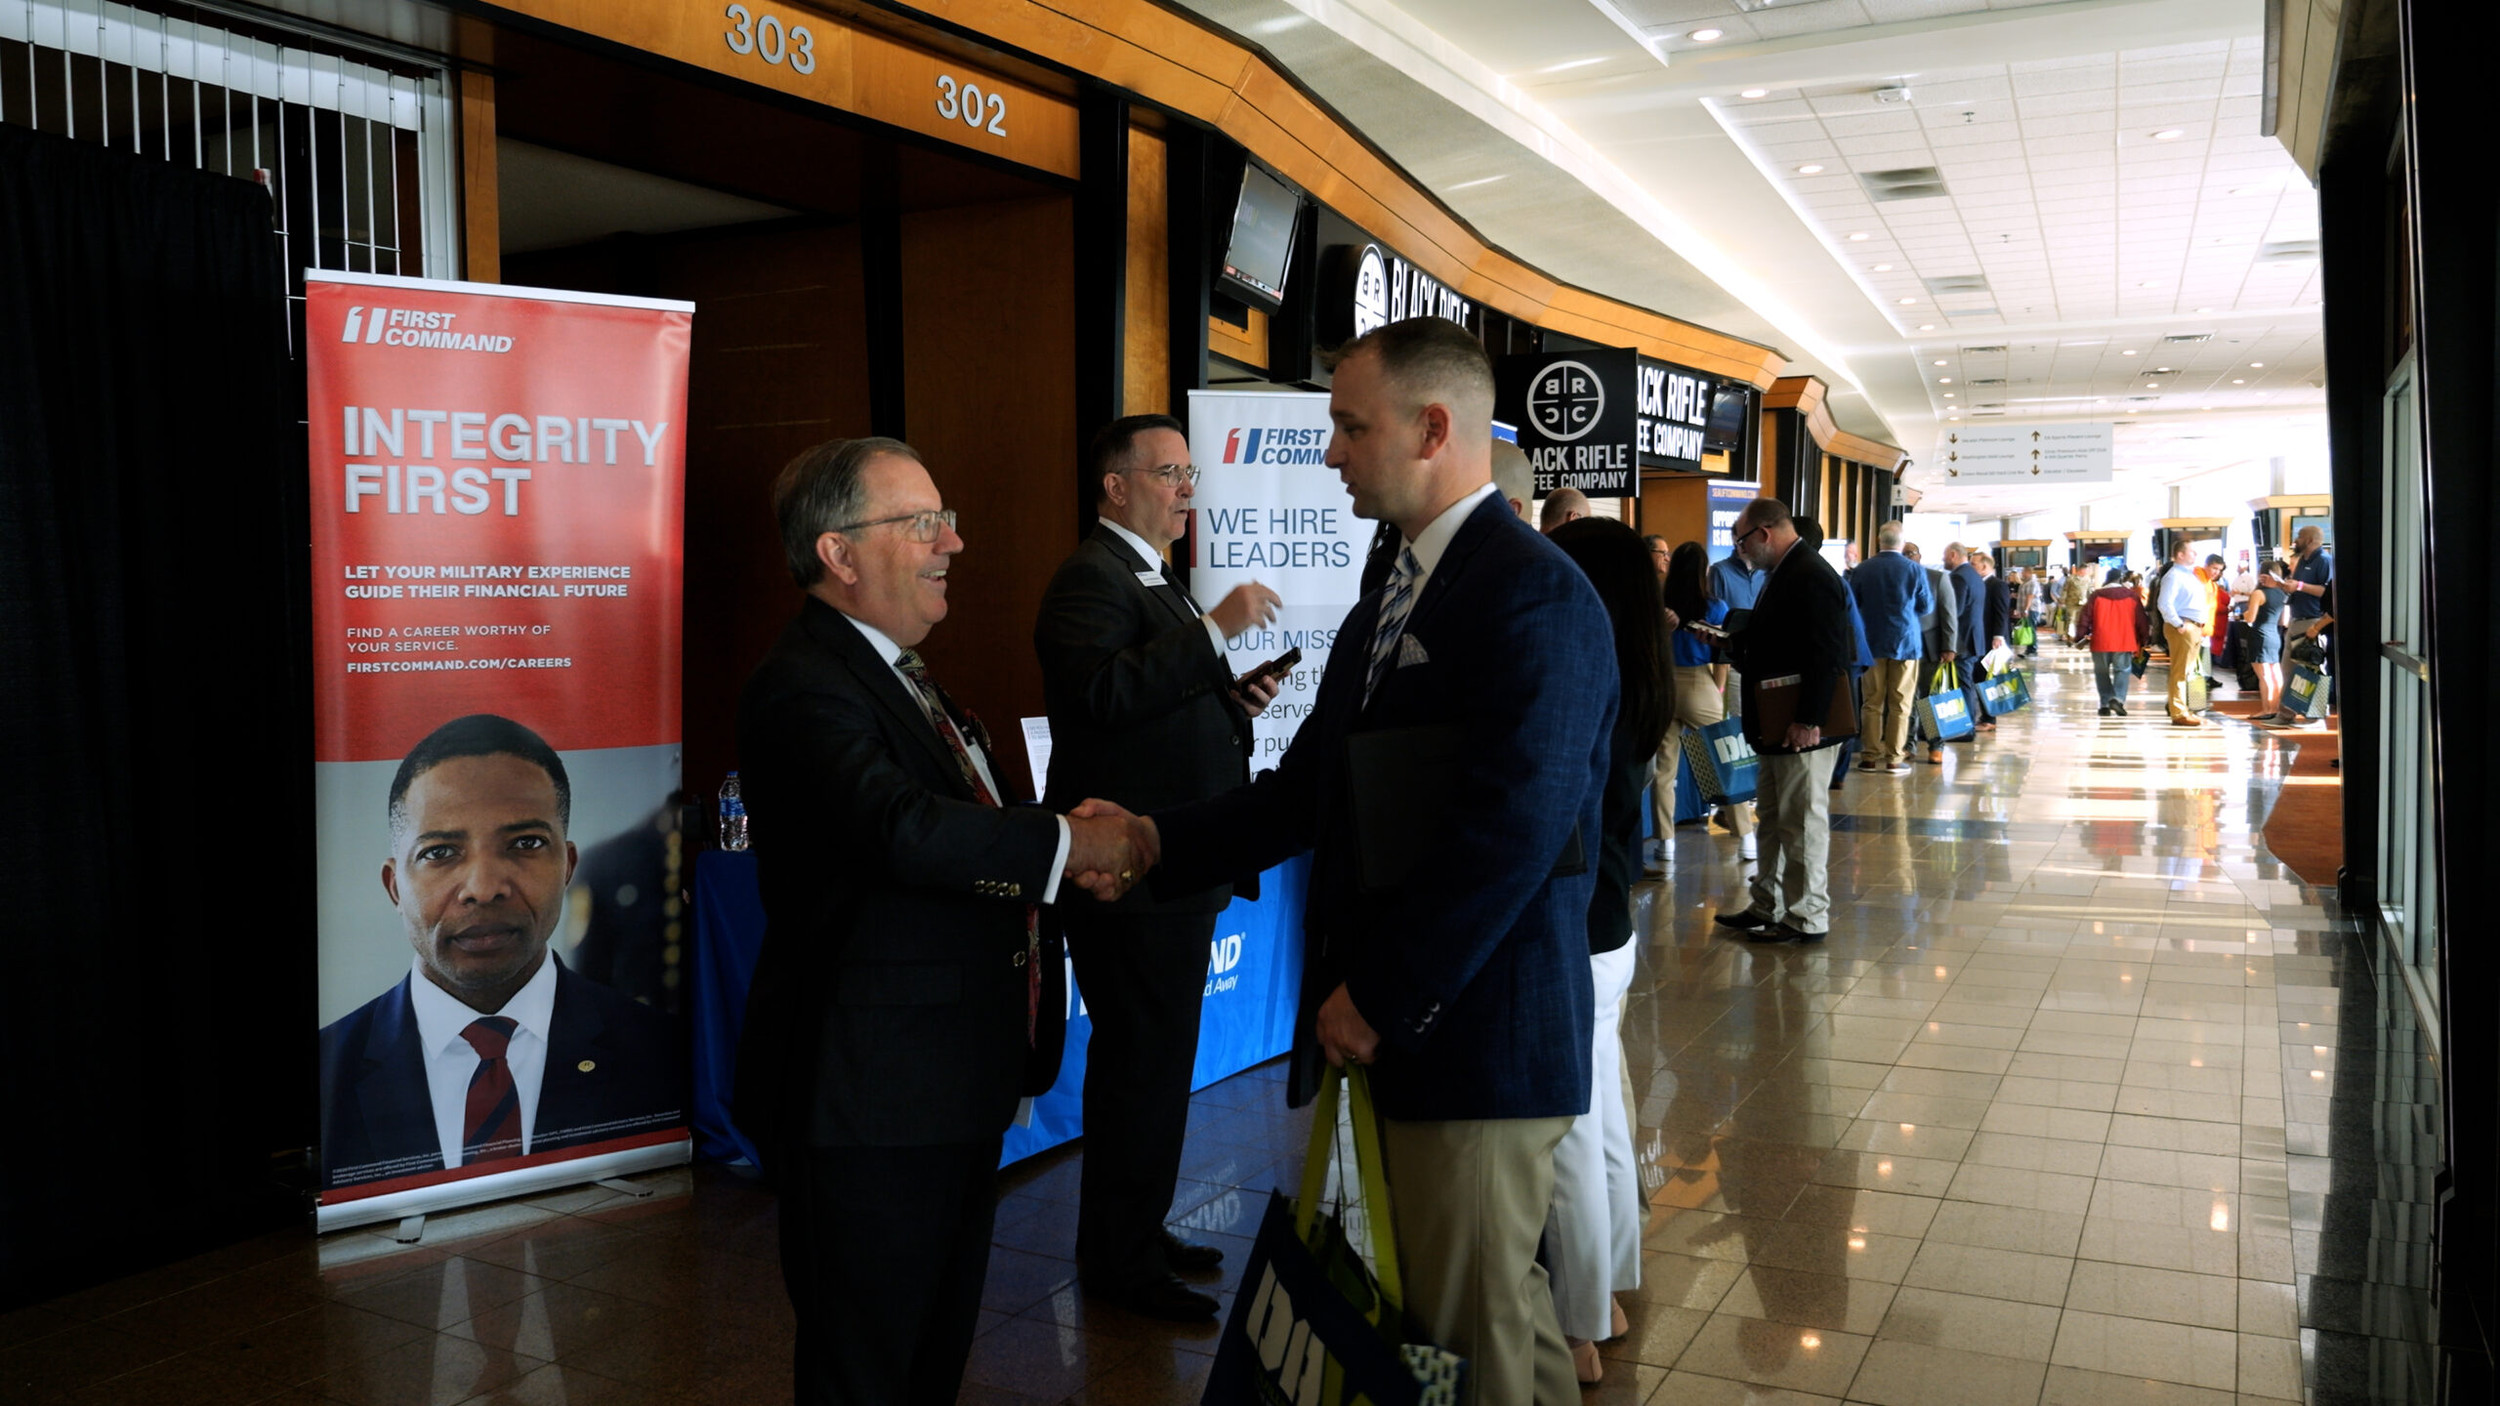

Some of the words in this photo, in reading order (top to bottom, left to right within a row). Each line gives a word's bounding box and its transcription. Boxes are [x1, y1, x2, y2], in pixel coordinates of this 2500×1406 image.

[725, 3, 816, 75] 303
[936, 74, 1007, 137] 302
[389, 309, 456, 330] FIRST
[385, 328, 513, 353] COMMAND
[1666, 373, 1708, 426] RIFLE
[344, 406, 669, 466] INTEGRITY
[1265, 428, 1326, 446] FIRST
[1654, 423, 1704, 462] COMPANY
[1575, 444, 1628, 470] RIFLE
[345, 463, 532, 516] FIRST
[1561, 471, 1627, 490] COMPANY
[1208, 508, 1258, 534] WE
[1270, 508, 1337, 534] HIRE
[1210, 541, 1350, 568] LEADERS
[345, 565, 380, 580] LET
[385, 565, 435, 580] YOUR
[440, 565, 523, 580] MILITARY
[528, 565, 631, 580] EXPERIENCE
[345, 584, 403, 599] GUIDE
[408, 584, 460, 599] THEIR
[464, 583, 560, 598] FINANCIAL
[563, 583, 628, 598] FUTURE
[347, 626, 383, 638] FIND
[388, 626, 399, 638] A
[403, 625, 460, 638] CAREER
[464, 624, 528, 637] WORTHY
[532, 624, 551, 636] OF
[1226, 631, 1275, 651] OUR
[347, 641, 390, 653] YOUR
[394, 640, 459, 653] SERVICE.
[347, 656, 572, 673] FIRSTCOMMAND.COM/CAREERS
